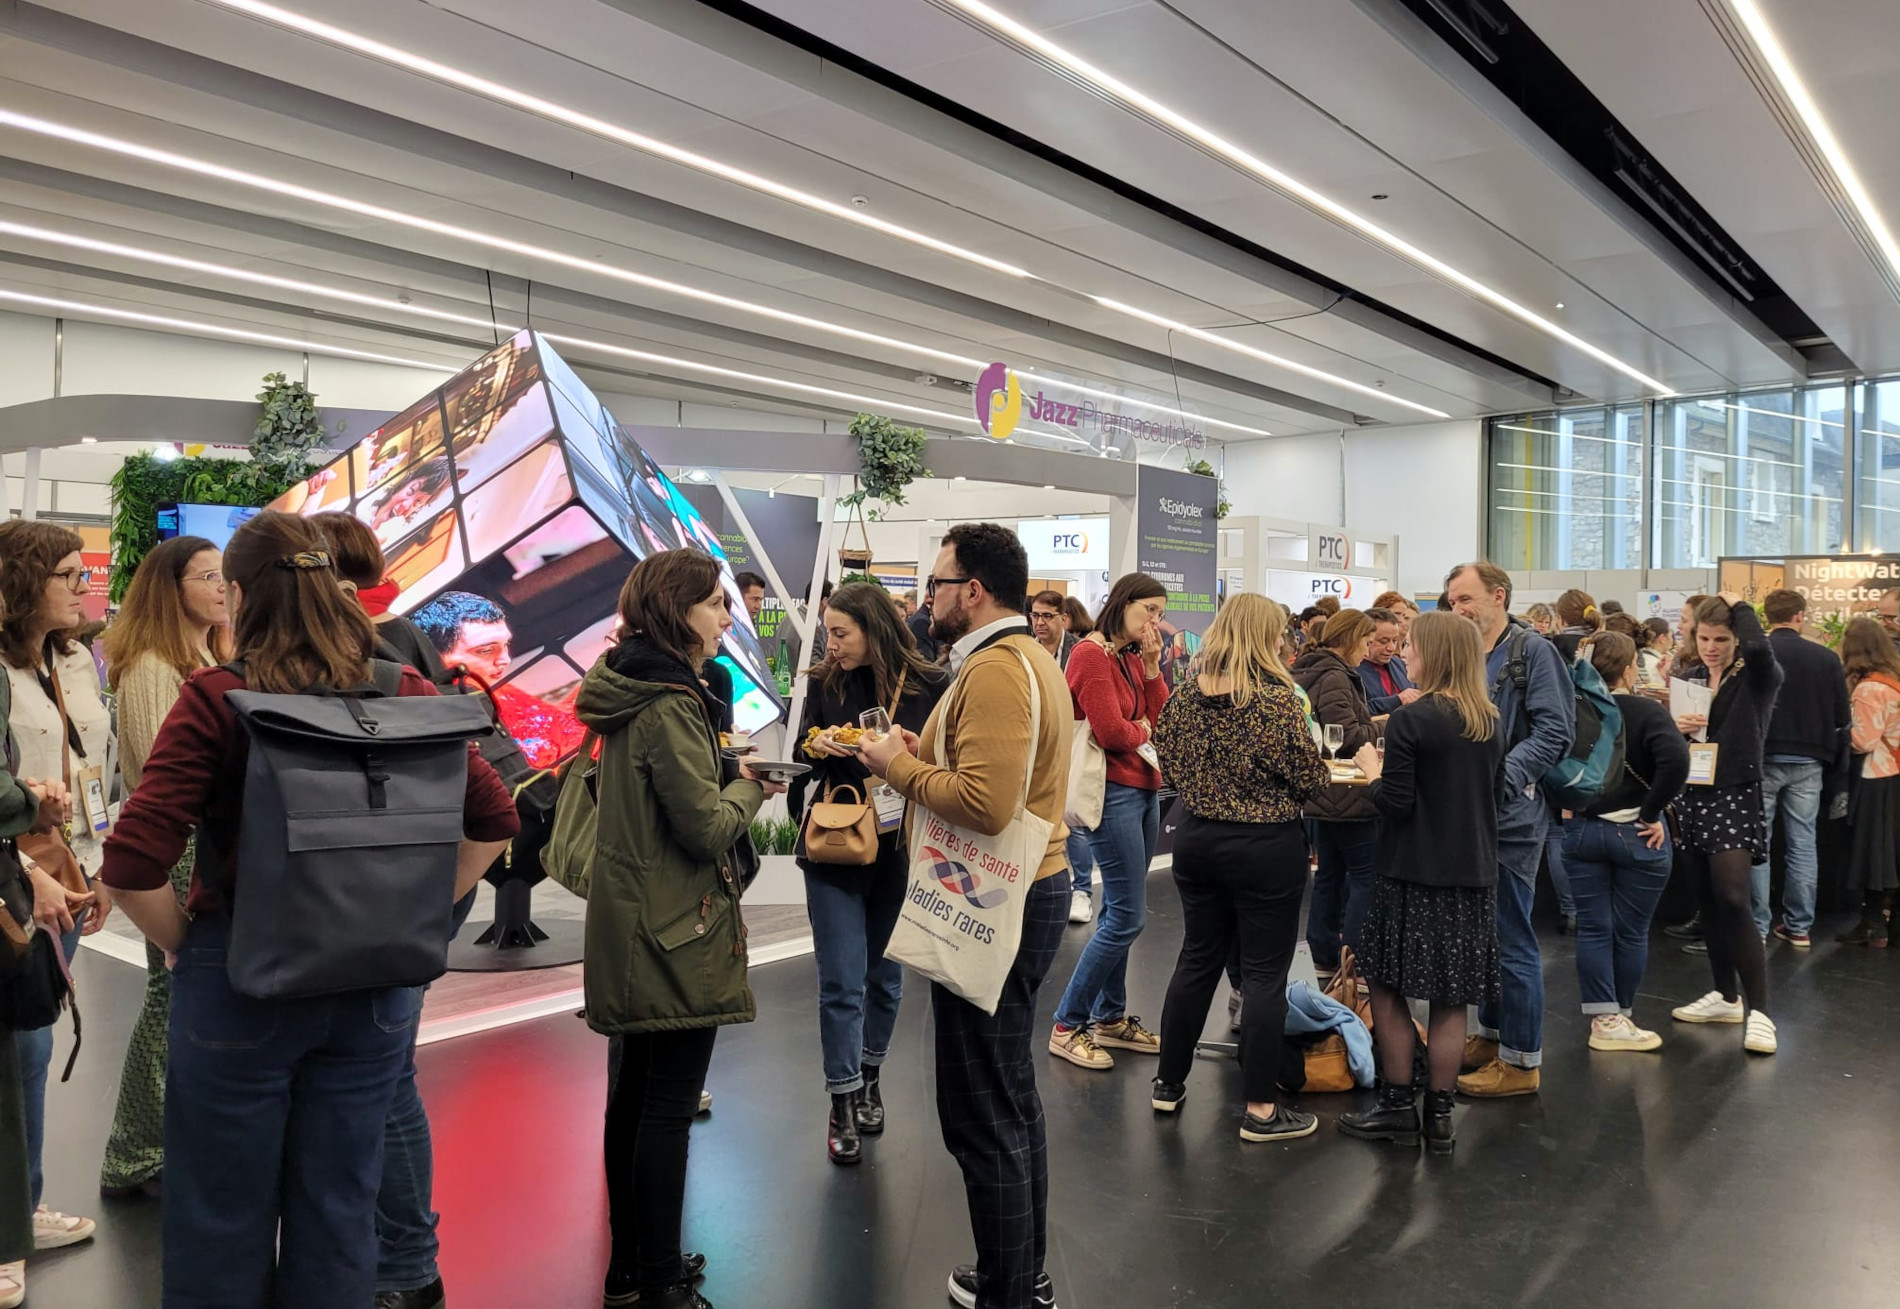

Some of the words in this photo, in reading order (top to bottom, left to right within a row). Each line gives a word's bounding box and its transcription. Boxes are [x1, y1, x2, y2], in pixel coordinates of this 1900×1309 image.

[1029, 391, 1078, 427] Jazz
[1082, 400, 1202, 450] Pharmaceuticals
[1167, 499, 1203, 519] Epidyolex
[1053, 534, 1080, 548] PTC
[1319, 535, 1343, 560] PTC
[1312, 579, 1342, 593] PTC
[766, 610, 777, 624] LA
[758, 624, 775, 638] VOS
[962, 840, 978, 862] de
[979, 852, 1020, 884] santé
[952, 911, 996, 945] rares
